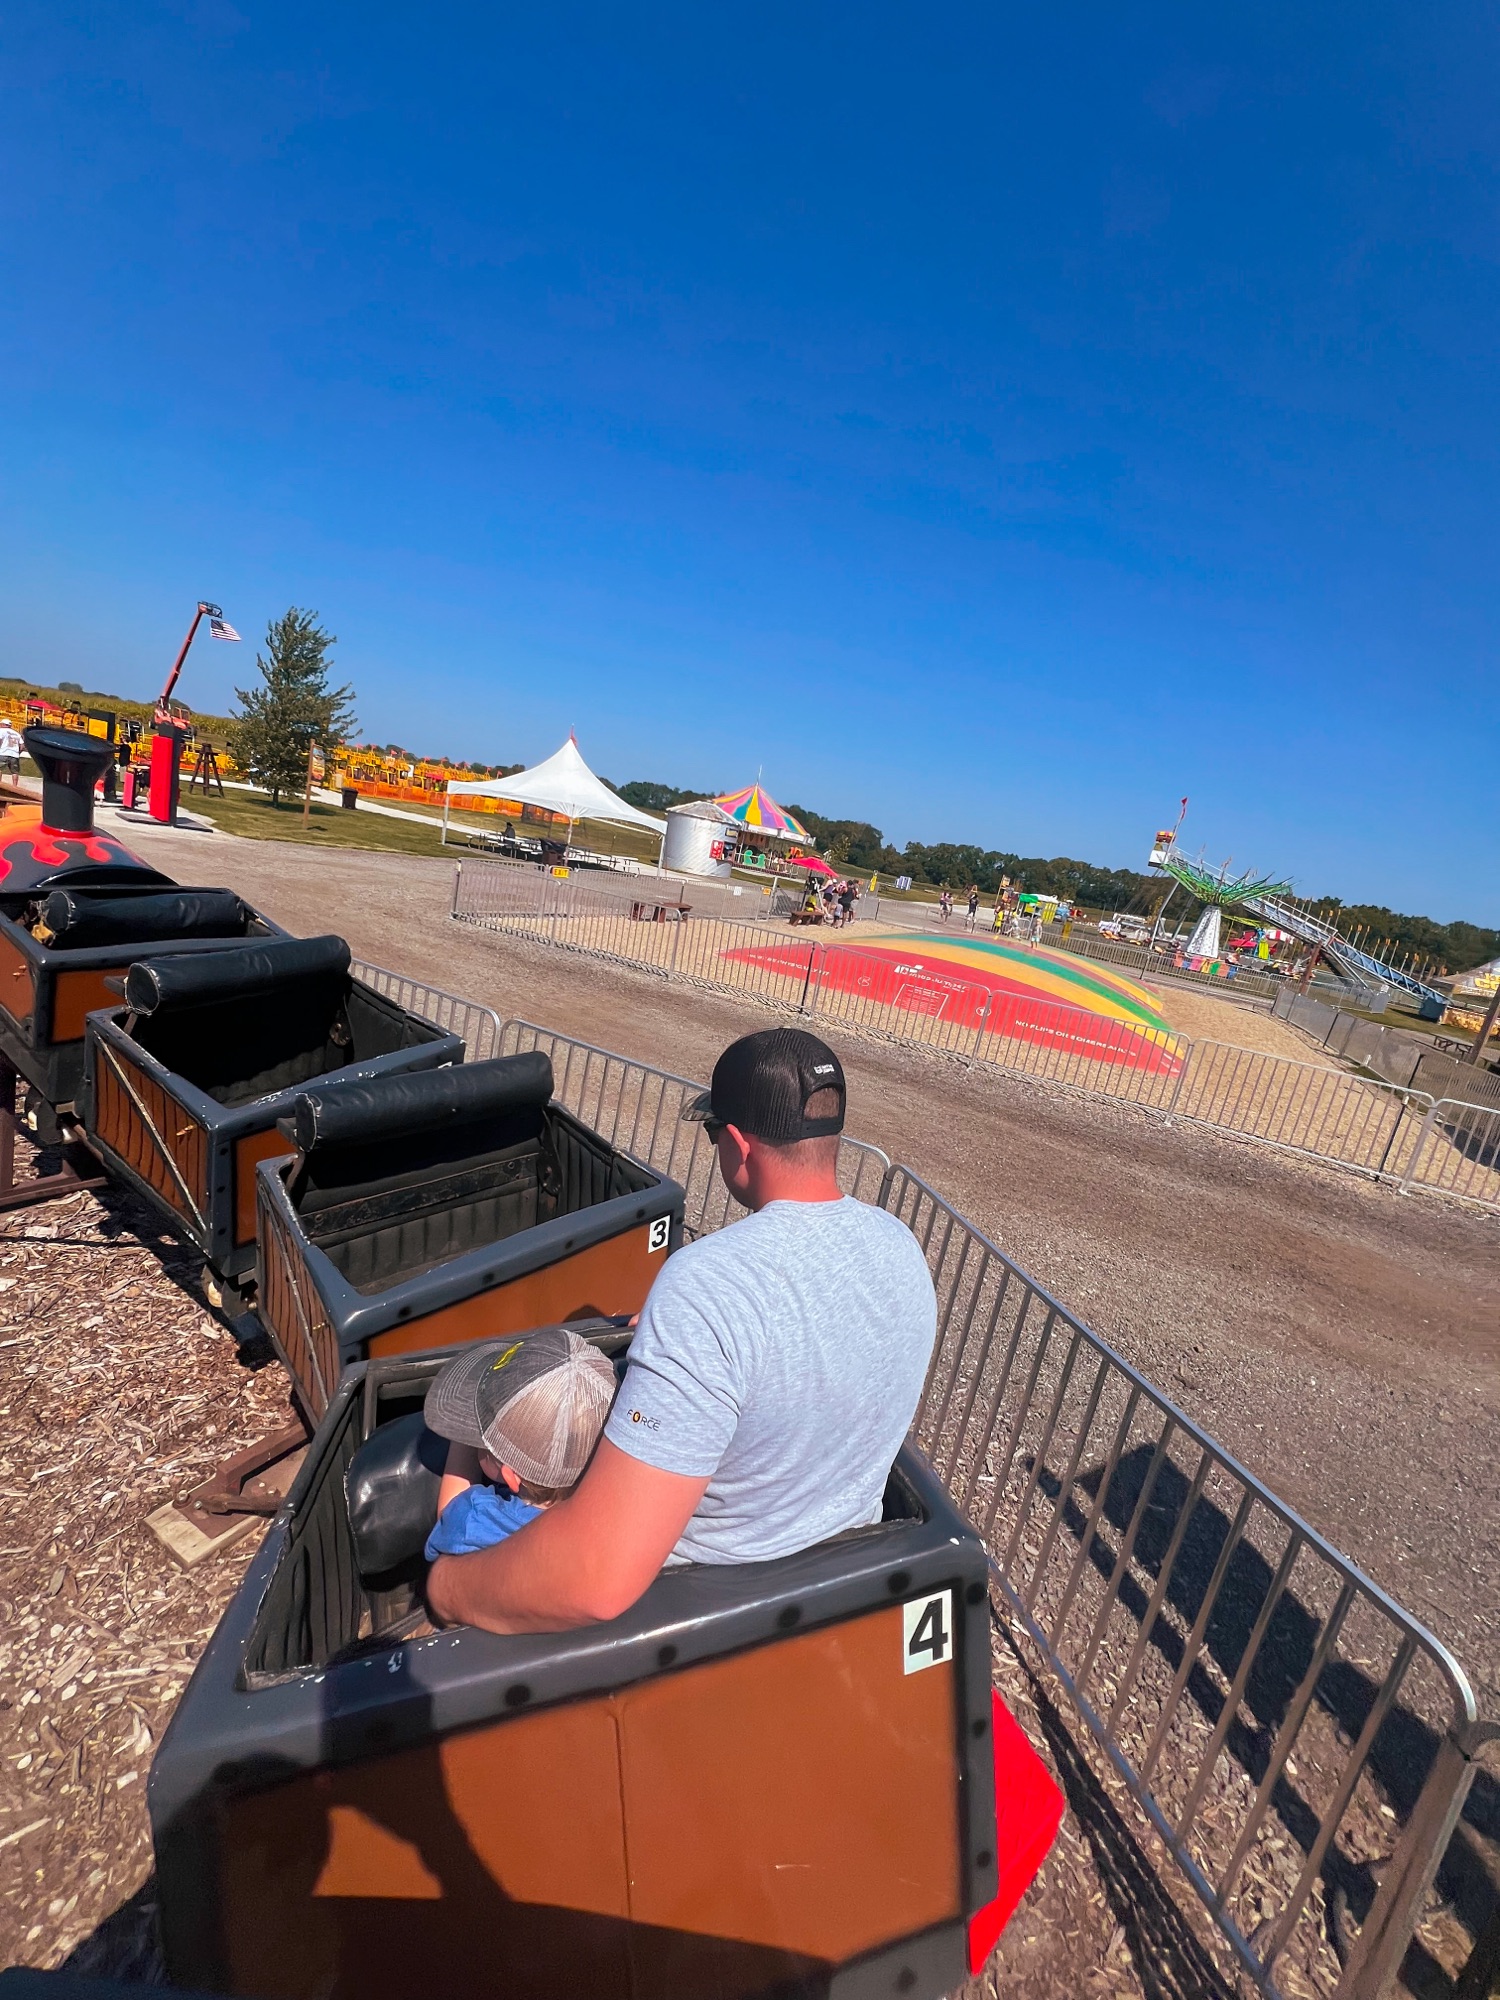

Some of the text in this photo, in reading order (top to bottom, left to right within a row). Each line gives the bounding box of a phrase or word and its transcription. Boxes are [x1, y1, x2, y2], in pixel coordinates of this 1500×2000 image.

[554, 868, 568, 876] EXIT
[1029, 1024, 1054, 1034] FLIPS
[652, 1220, 667, 1247] 3
[627, 1409, 661, 1432] FORCE
[909, 1598, 948, 1661] 4
